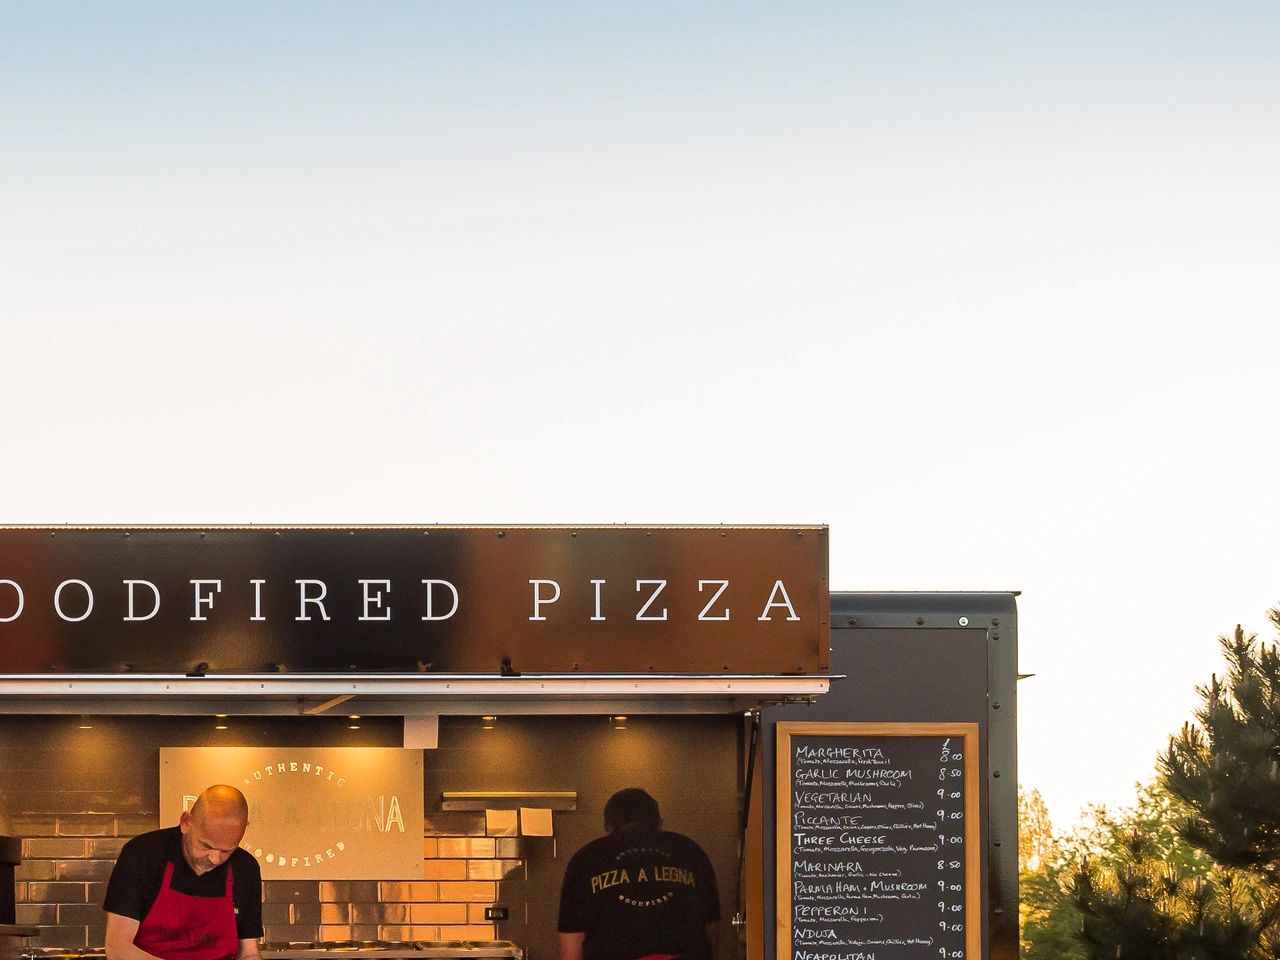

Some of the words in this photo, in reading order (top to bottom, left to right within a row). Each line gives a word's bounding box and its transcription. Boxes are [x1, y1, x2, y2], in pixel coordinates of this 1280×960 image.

[529, 579, 801, 622] PIZZA
[795, 746, 884, 759] MARGHERITA
[795, 769, 840, 780] GARLIC
[846, 769, 912, 779] MUSHROOM
[939, 768, 962, 780] 8.50
[795, 791, 872, 804] VEGETARIAN
[937, 788, 961, 800] 9.00
[794, 810, 863, 826] PICCANTE
[937, 810, 963, 821] 9.00
[793, 833, 836, 846] THREE
[839, 832, 887, 845] CHEESE
[938, 834, 963, 846] 9.00
[793, 860, 863, 873] MARINARA
[937, 860, 961, 870] 8.50
[591, 868, 630, 893] PIZZA
[638, 867, 648, 882] A
[654, 865, 696, 888] LEGNA
[794, 880, 833, 894] PARMA
[835, 881, 861, 893] HAM
[870, 880, 928, 892] MUSHROOM
[937, 880, 962, 892] 9.00
[937, 901, 963, 912] 9.00
[939, 921, 963, 932] 9.00
[939, 947, 964, 959] 9.00
